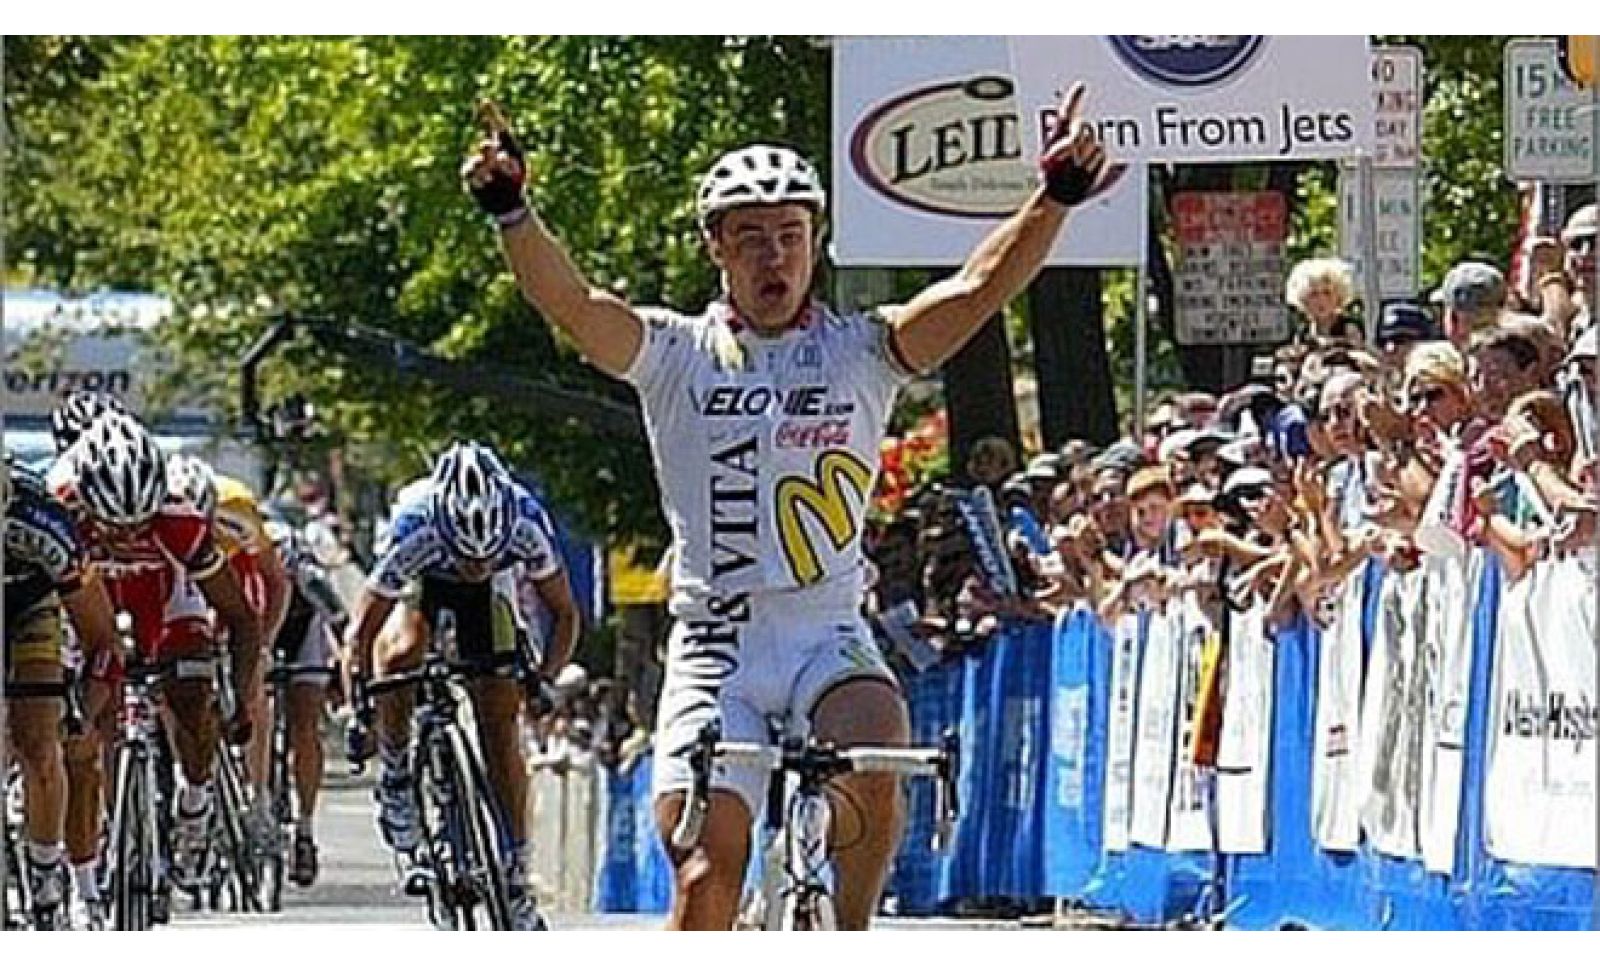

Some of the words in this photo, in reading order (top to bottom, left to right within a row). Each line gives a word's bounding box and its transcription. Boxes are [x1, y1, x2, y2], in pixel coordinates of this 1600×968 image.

[1516, 63, 1545, 98] 15
[1157, 109, 1266, 145] From
[1279, 104, 1353, 154] Jets
[1526, 107, 1575, 129] FREE
[1514, 136, 1590, 159] PARKING
[710, 436, 760, 577] VITA
